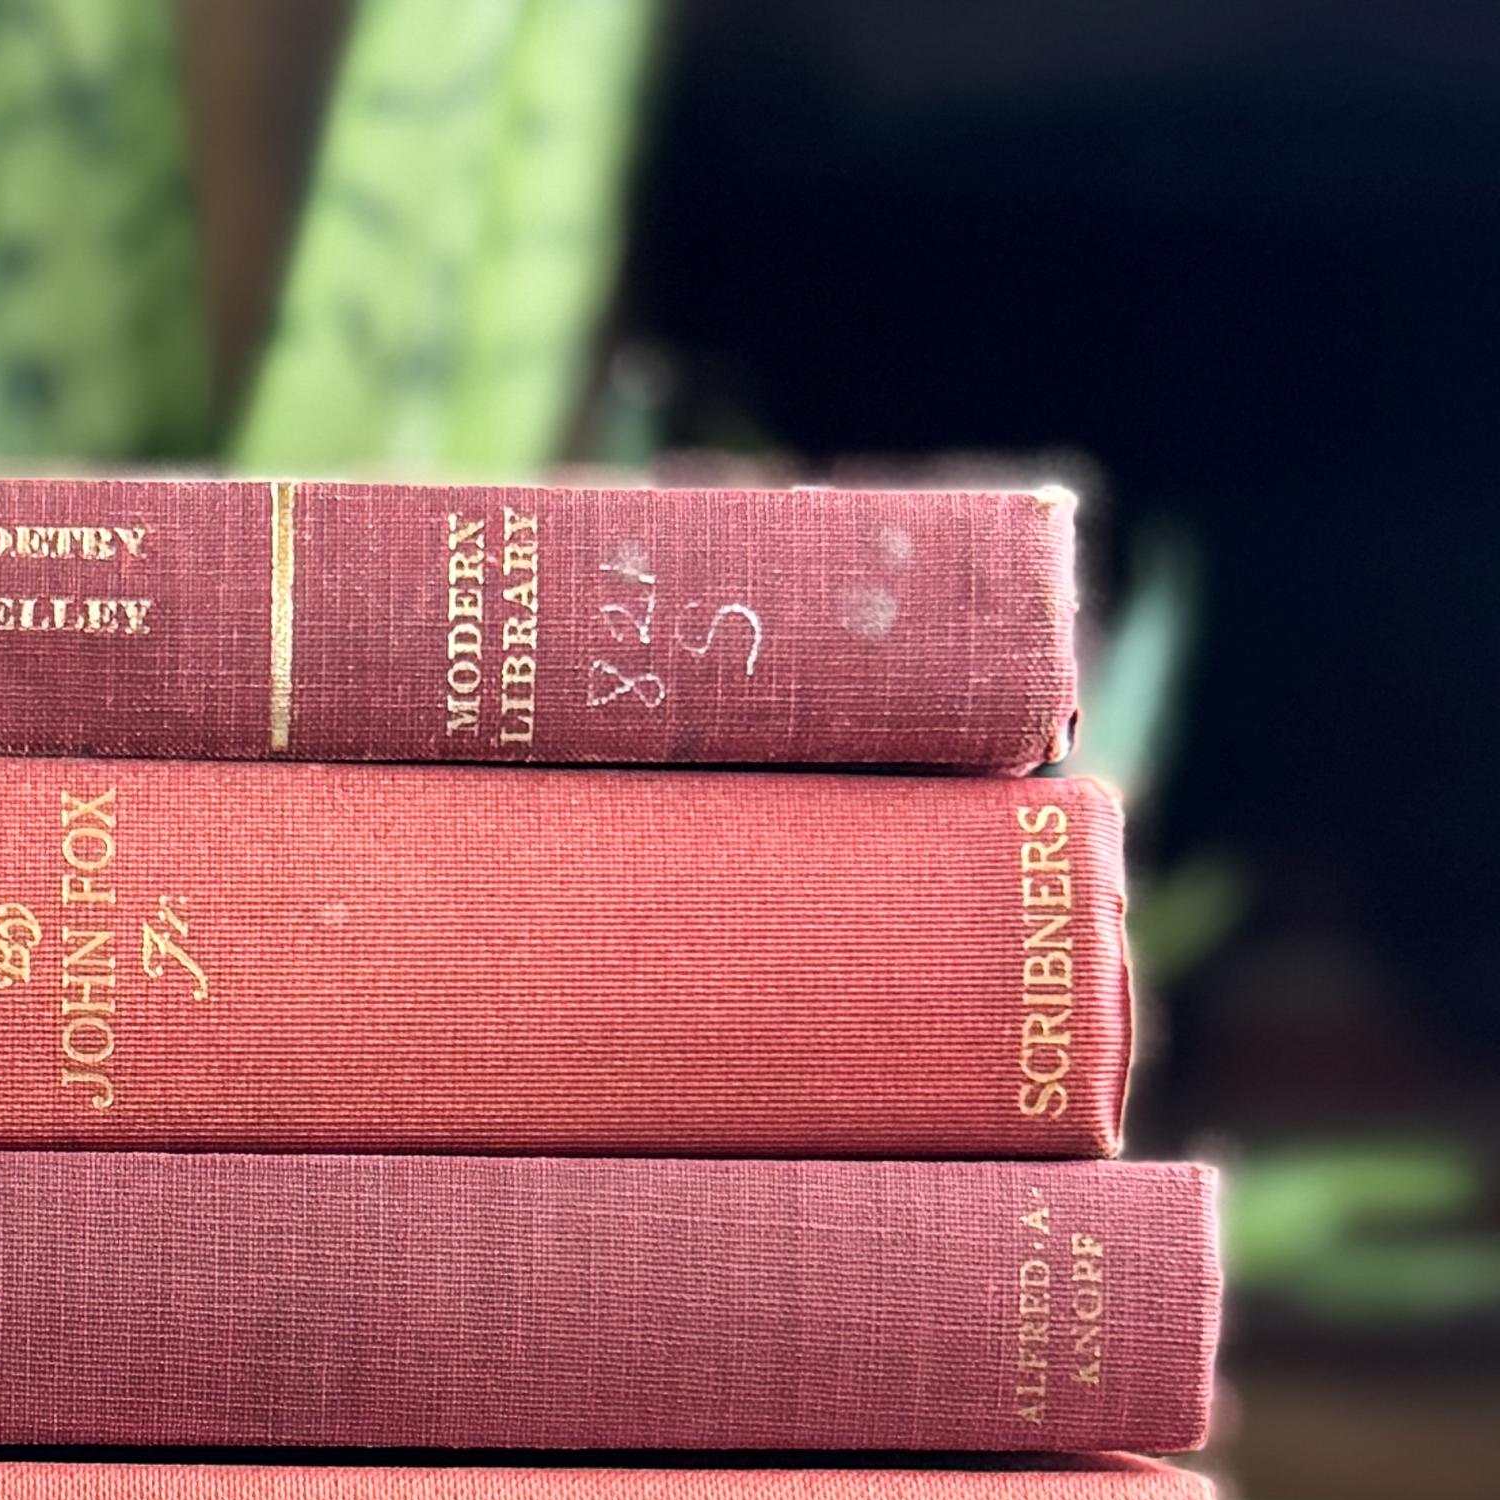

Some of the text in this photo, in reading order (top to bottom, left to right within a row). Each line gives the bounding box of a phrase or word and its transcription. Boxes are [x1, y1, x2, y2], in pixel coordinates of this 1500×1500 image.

[447, 513, 485, 736] MODERN
[500, 507, 538, 746] LIBRARY
[61, 786, 117, 1109] JOHN FOX
[1017, 804, 1073, 1119] SCRIBNERS
[1015, 1259, 1050, 1425] ALFRED
[1070, 1233, 1103, 1385] KNOPF
